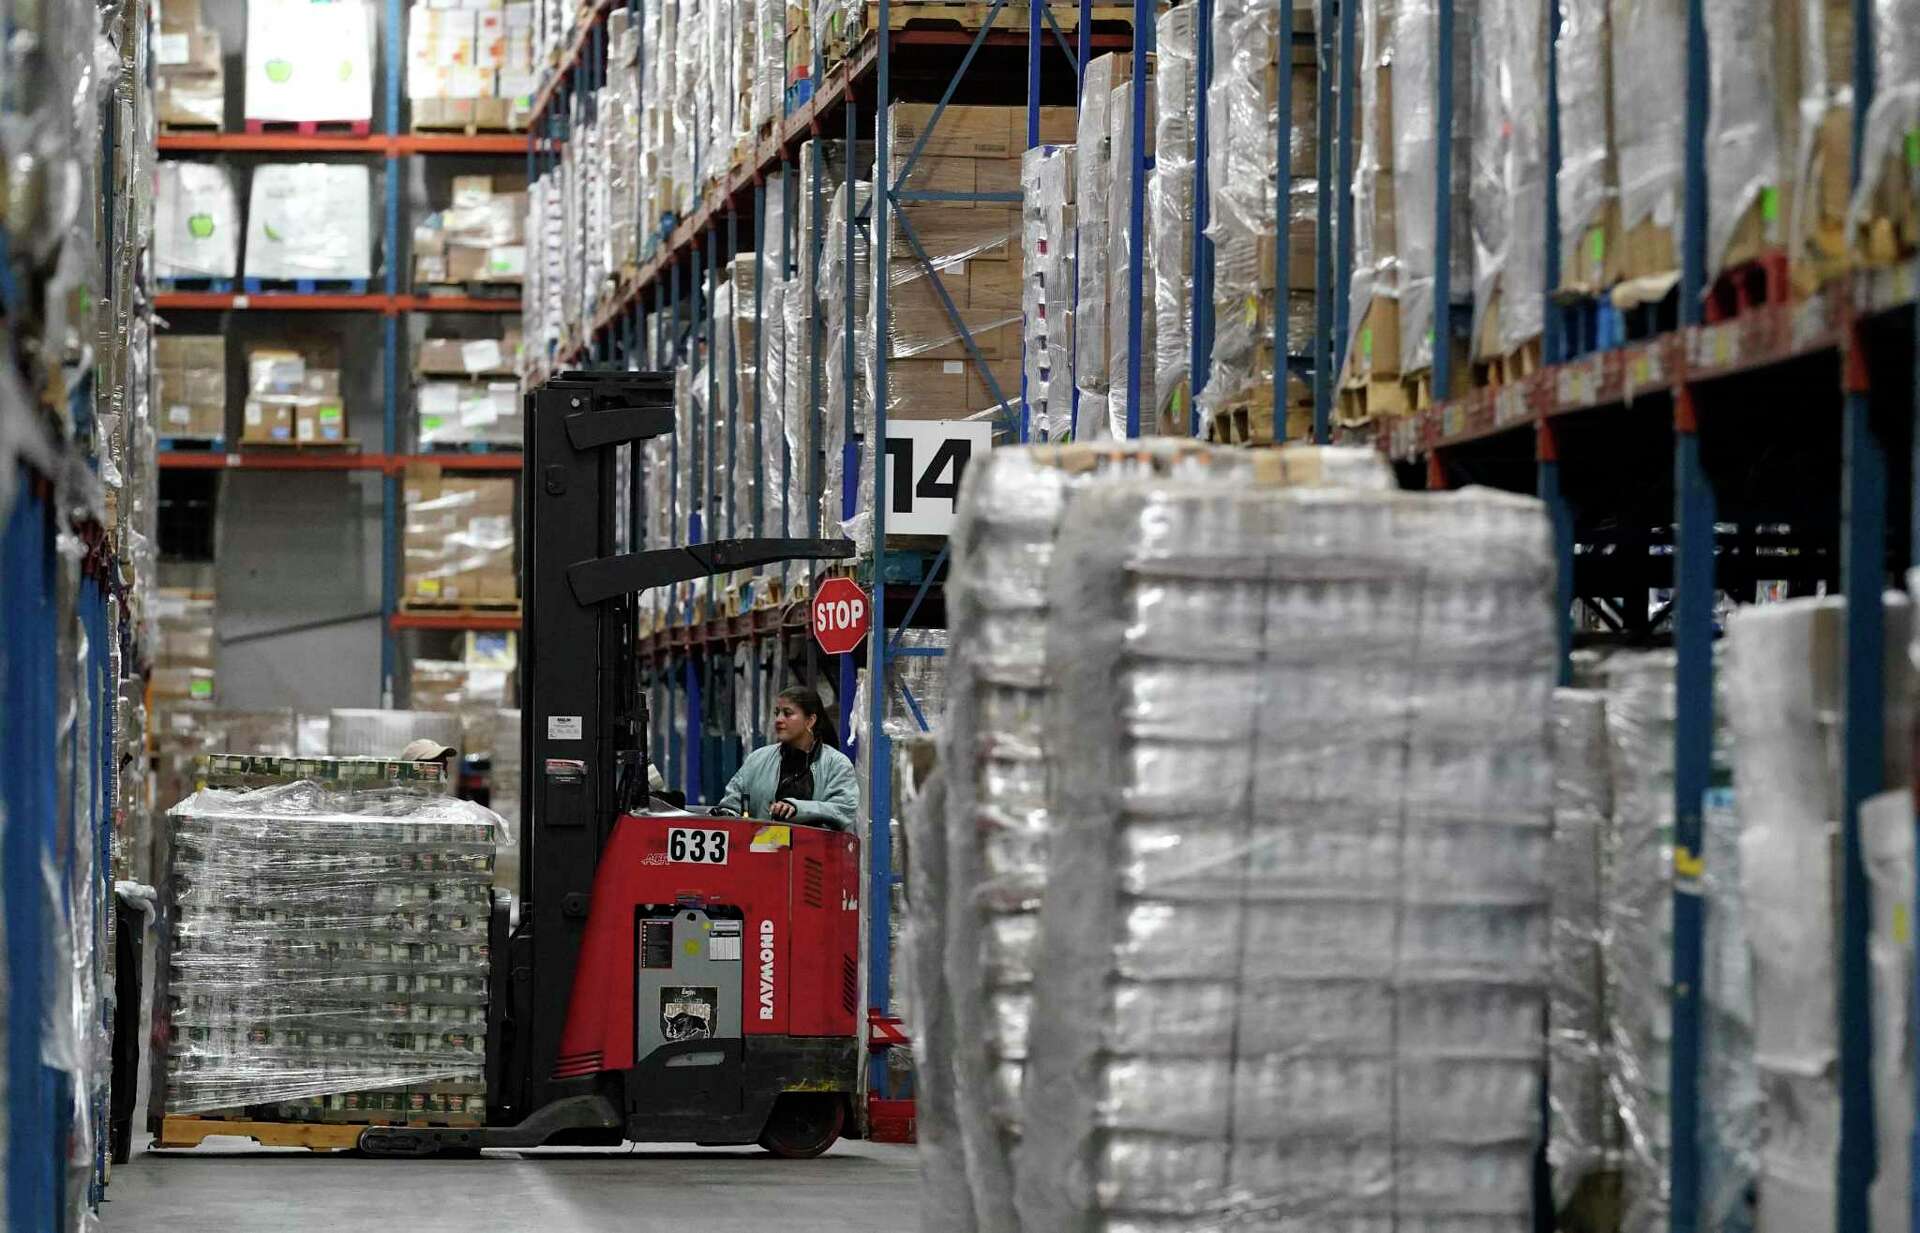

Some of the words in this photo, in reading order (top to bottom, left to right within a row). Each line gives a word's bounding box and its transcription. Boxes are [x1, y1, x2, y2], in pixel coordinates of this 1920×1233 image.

[884, 438, 971, 514] 14
[817, 599, 864, 632] STOP
[670, 829, 727, 863] 633
[760, 920, 774, 1020] RAYMOND
